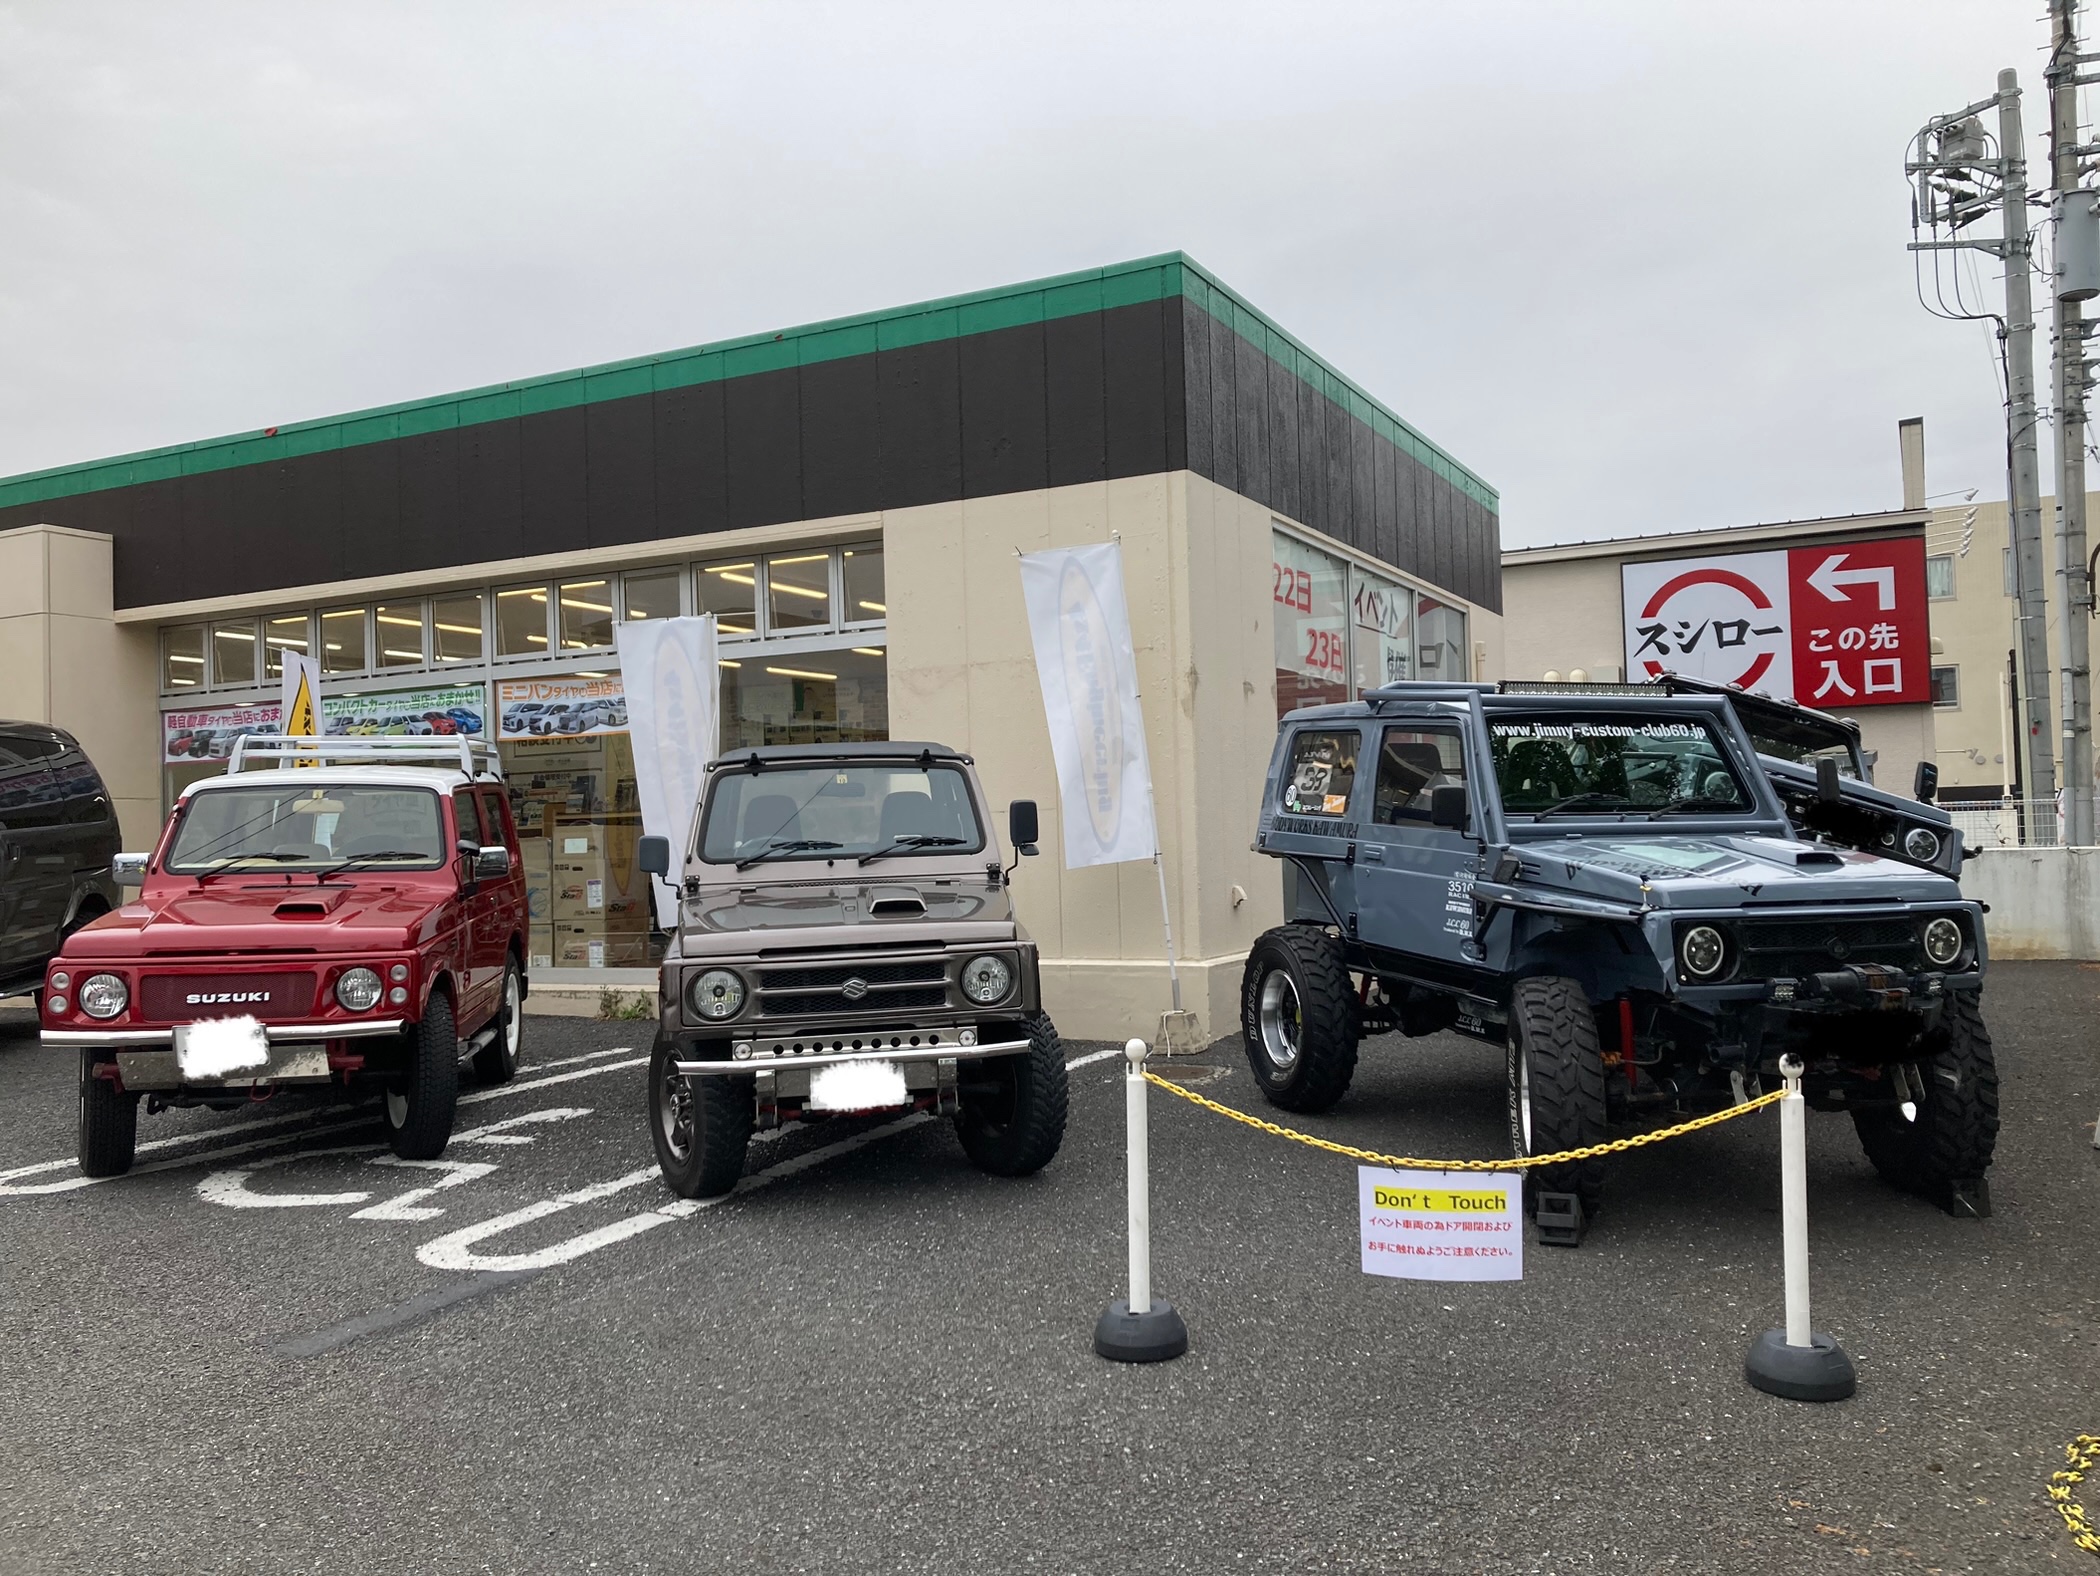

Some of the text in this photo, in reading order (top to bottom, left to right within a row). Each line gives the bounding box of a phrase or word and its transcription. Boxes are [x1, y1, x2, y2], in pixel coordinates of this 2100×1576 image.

[1633, 617, 1784, 658] スシロー
[1808, 622, 1899, 652] この先
[1305, 628, 1344, 674] 23日
[1813, 657, 1903, 699] 入口
[1493, 723, 1706, 740] www.jimny-custom-club60.jp
[186, 992, 270, 1004] SUZUKI
[1448, 1195, 1507, 1211] Touch
[1368, 1216, 1513, 1232] イベント車両の為ドア開閉および
[1368, 1240, 1513, 1257] お手に触れぬようご注意ください。
